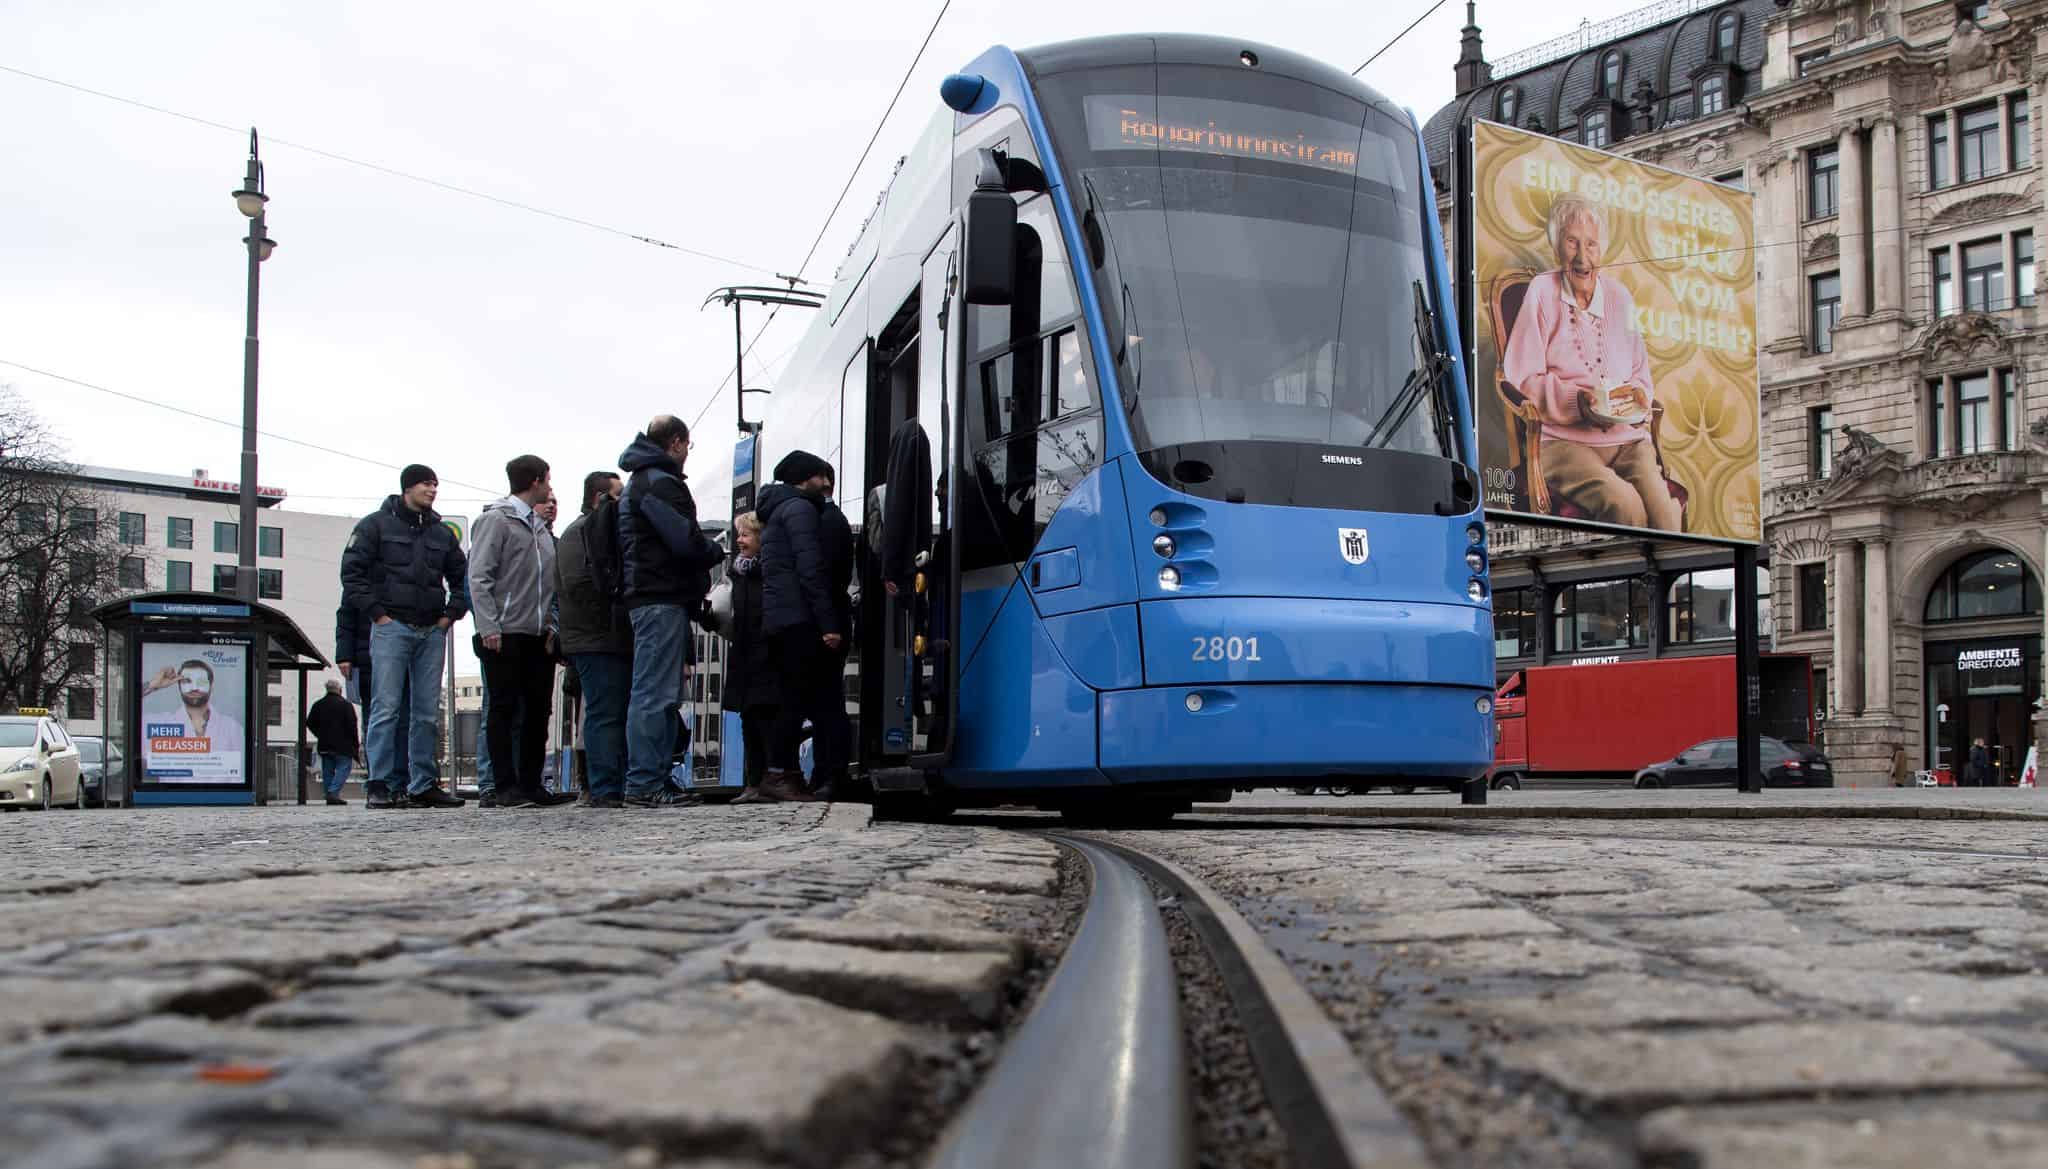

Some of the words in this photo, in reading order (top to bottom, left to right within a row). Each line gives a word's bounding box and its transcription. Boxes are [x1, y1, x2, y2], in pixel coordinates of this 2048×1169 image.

[1522, 158, 1574, 193] EIN
[1576, 171, 1738, 234] GRÖSSERES
[1652, 229, 1738, 277] STÜCK
[1671, 275, 1737, 313] VOM
[1626, 303, 1753, 354] KUCHEN?
[1321, 454, 1363, 466] SIEMENS
[1486, 466, 1516, 490] 100
[1486, 491, 1516, 505] JAHRE
[1191, 636, 1262, 661] 2801
[1958, 648, 2020, 661] AMBIENTE
[151, 727, 182, 737] MEHR
[155, 740, 207, 751] GELASSEN
